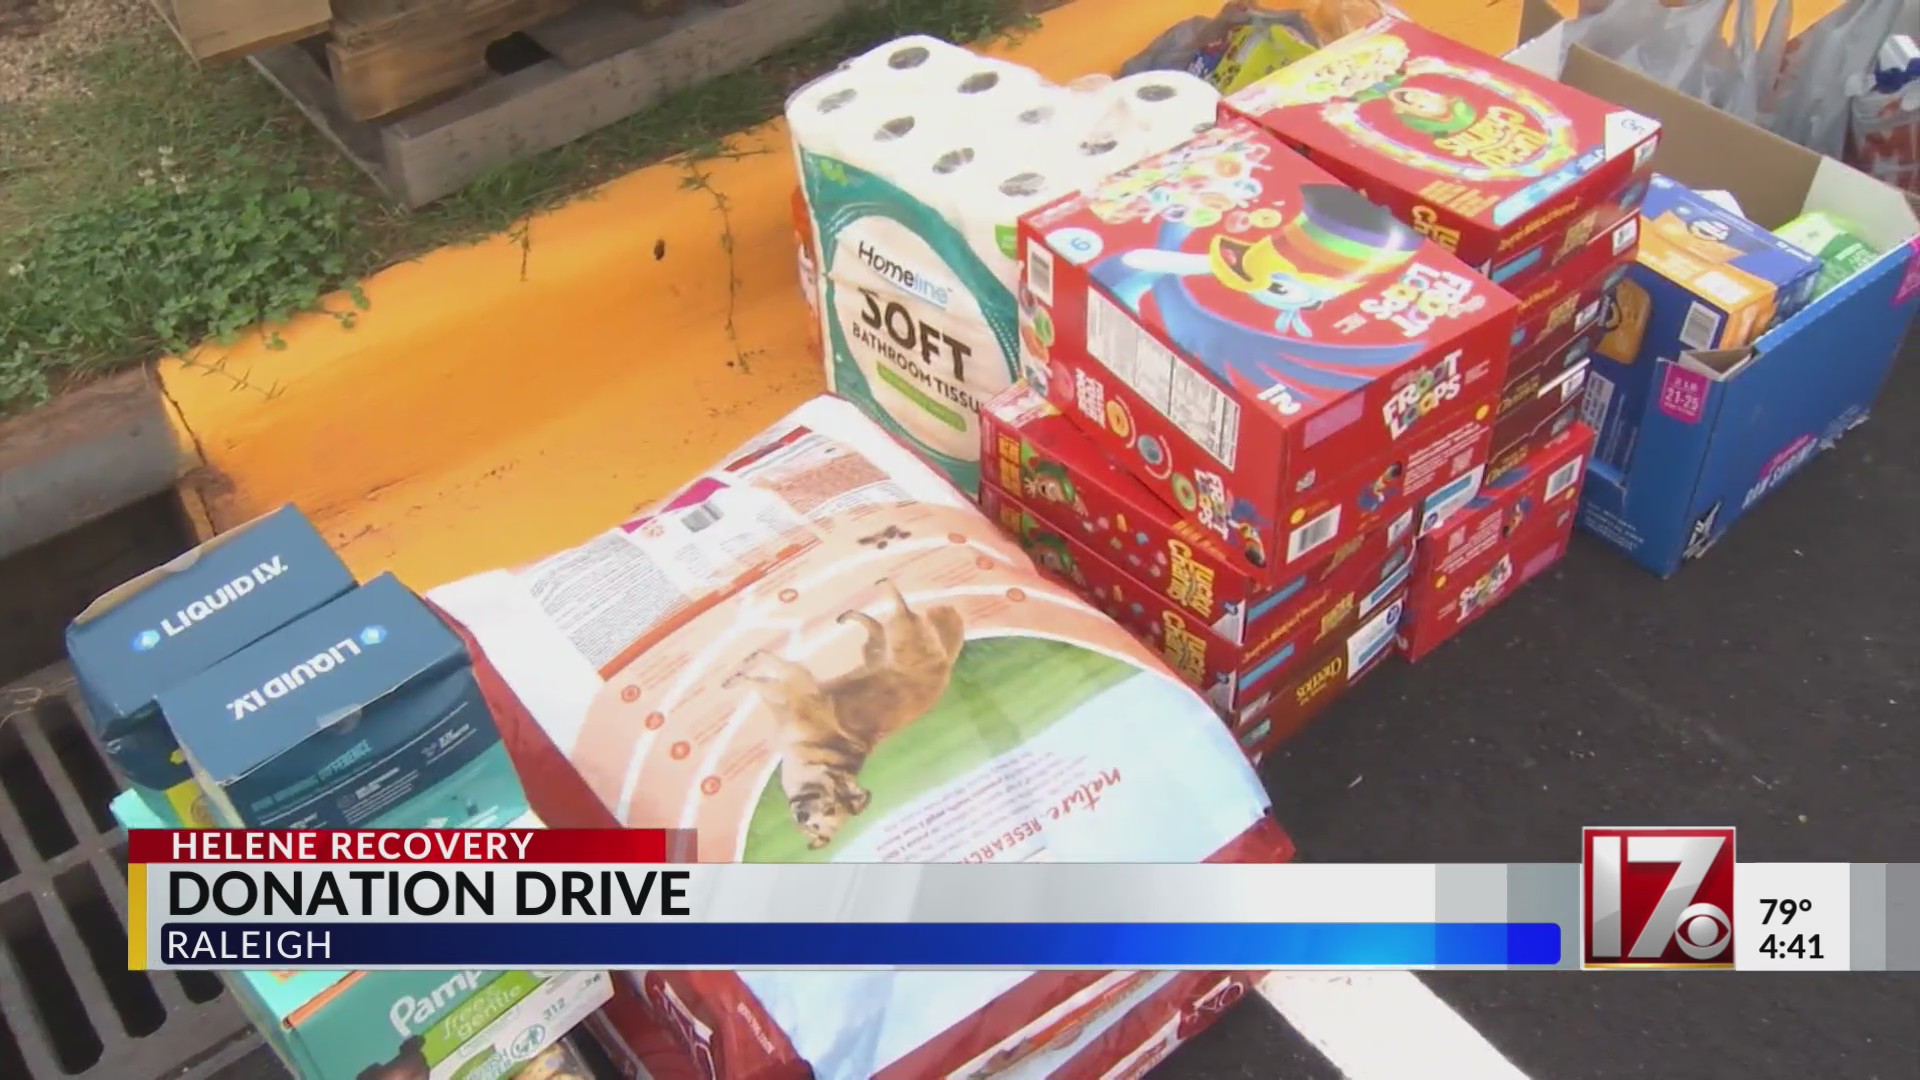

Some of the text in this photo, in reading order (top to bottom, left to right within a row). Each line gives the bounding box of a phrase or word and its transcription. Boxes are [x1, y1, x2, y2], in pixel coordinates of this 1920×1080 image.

[852, 322, 984, 415] BATHROOM TISSU
[858, 285, 972, 383] SOFT
[160, 574, 256, 638] LIQUID
[262, 637, 362, 700] LIQUID
